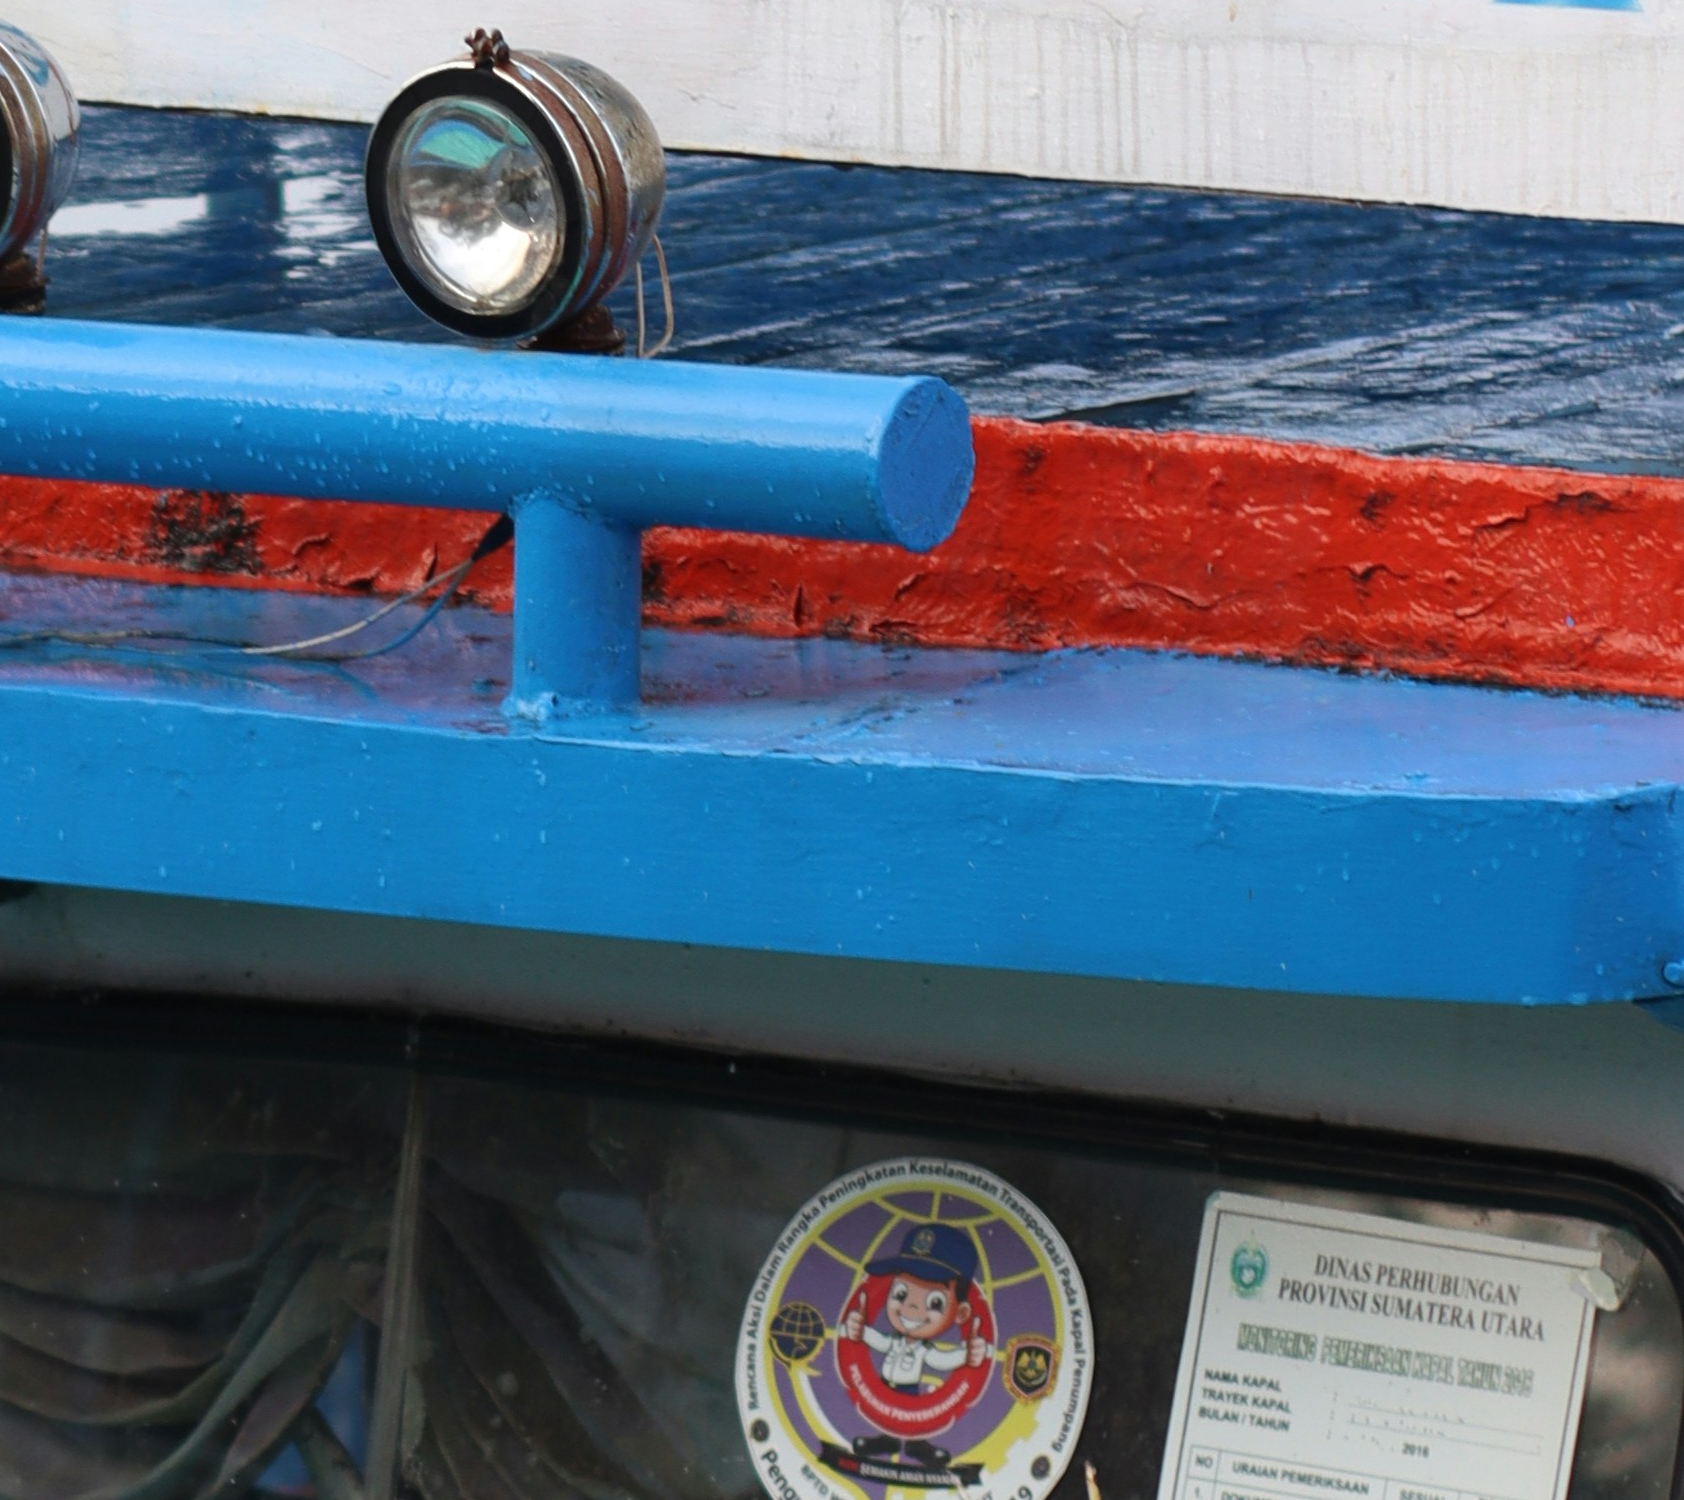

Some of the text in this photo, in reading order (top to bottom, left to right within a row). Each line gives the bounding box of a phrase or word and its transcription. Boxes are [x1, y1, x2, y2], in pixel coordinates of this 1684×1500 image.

[819, 1164, 906, 1211] Peningkatan
[909, 1161, 999, 1195] Keselamatan
[778, 1206, 820, 1255] Rangka
[998, 1187, 1064, 1268] Transportasi
[754, 1255, 782, 1303] Dalam
[1058, 1266, 1078, 1308] Pada
[1314, 1253, 1521, 1307] DINAS PERHUBUNGAN
[1070, 1308, 1086, 1355] Kapal
[1278, 1277, 1546, 1342] PROVINSI SUMATERA UTARA
[1201, 1386, 1292, 1414] TRAYEK KAPAL
[1203, 1368, 1283, 1393] NAMA KAPAL
[1051, 1357, 1087, 1454] Penumpang
[1197, 1405, 1239, 1424] BULAN
[1248, 1414, 1291, 1433] TAHUN
[1194, 1454, 1215, 1469] NO
[1232, 1460, 1278, 1481] URAIAN
[1280, 1470, 1371, 1496] PEMERIKSAAN
